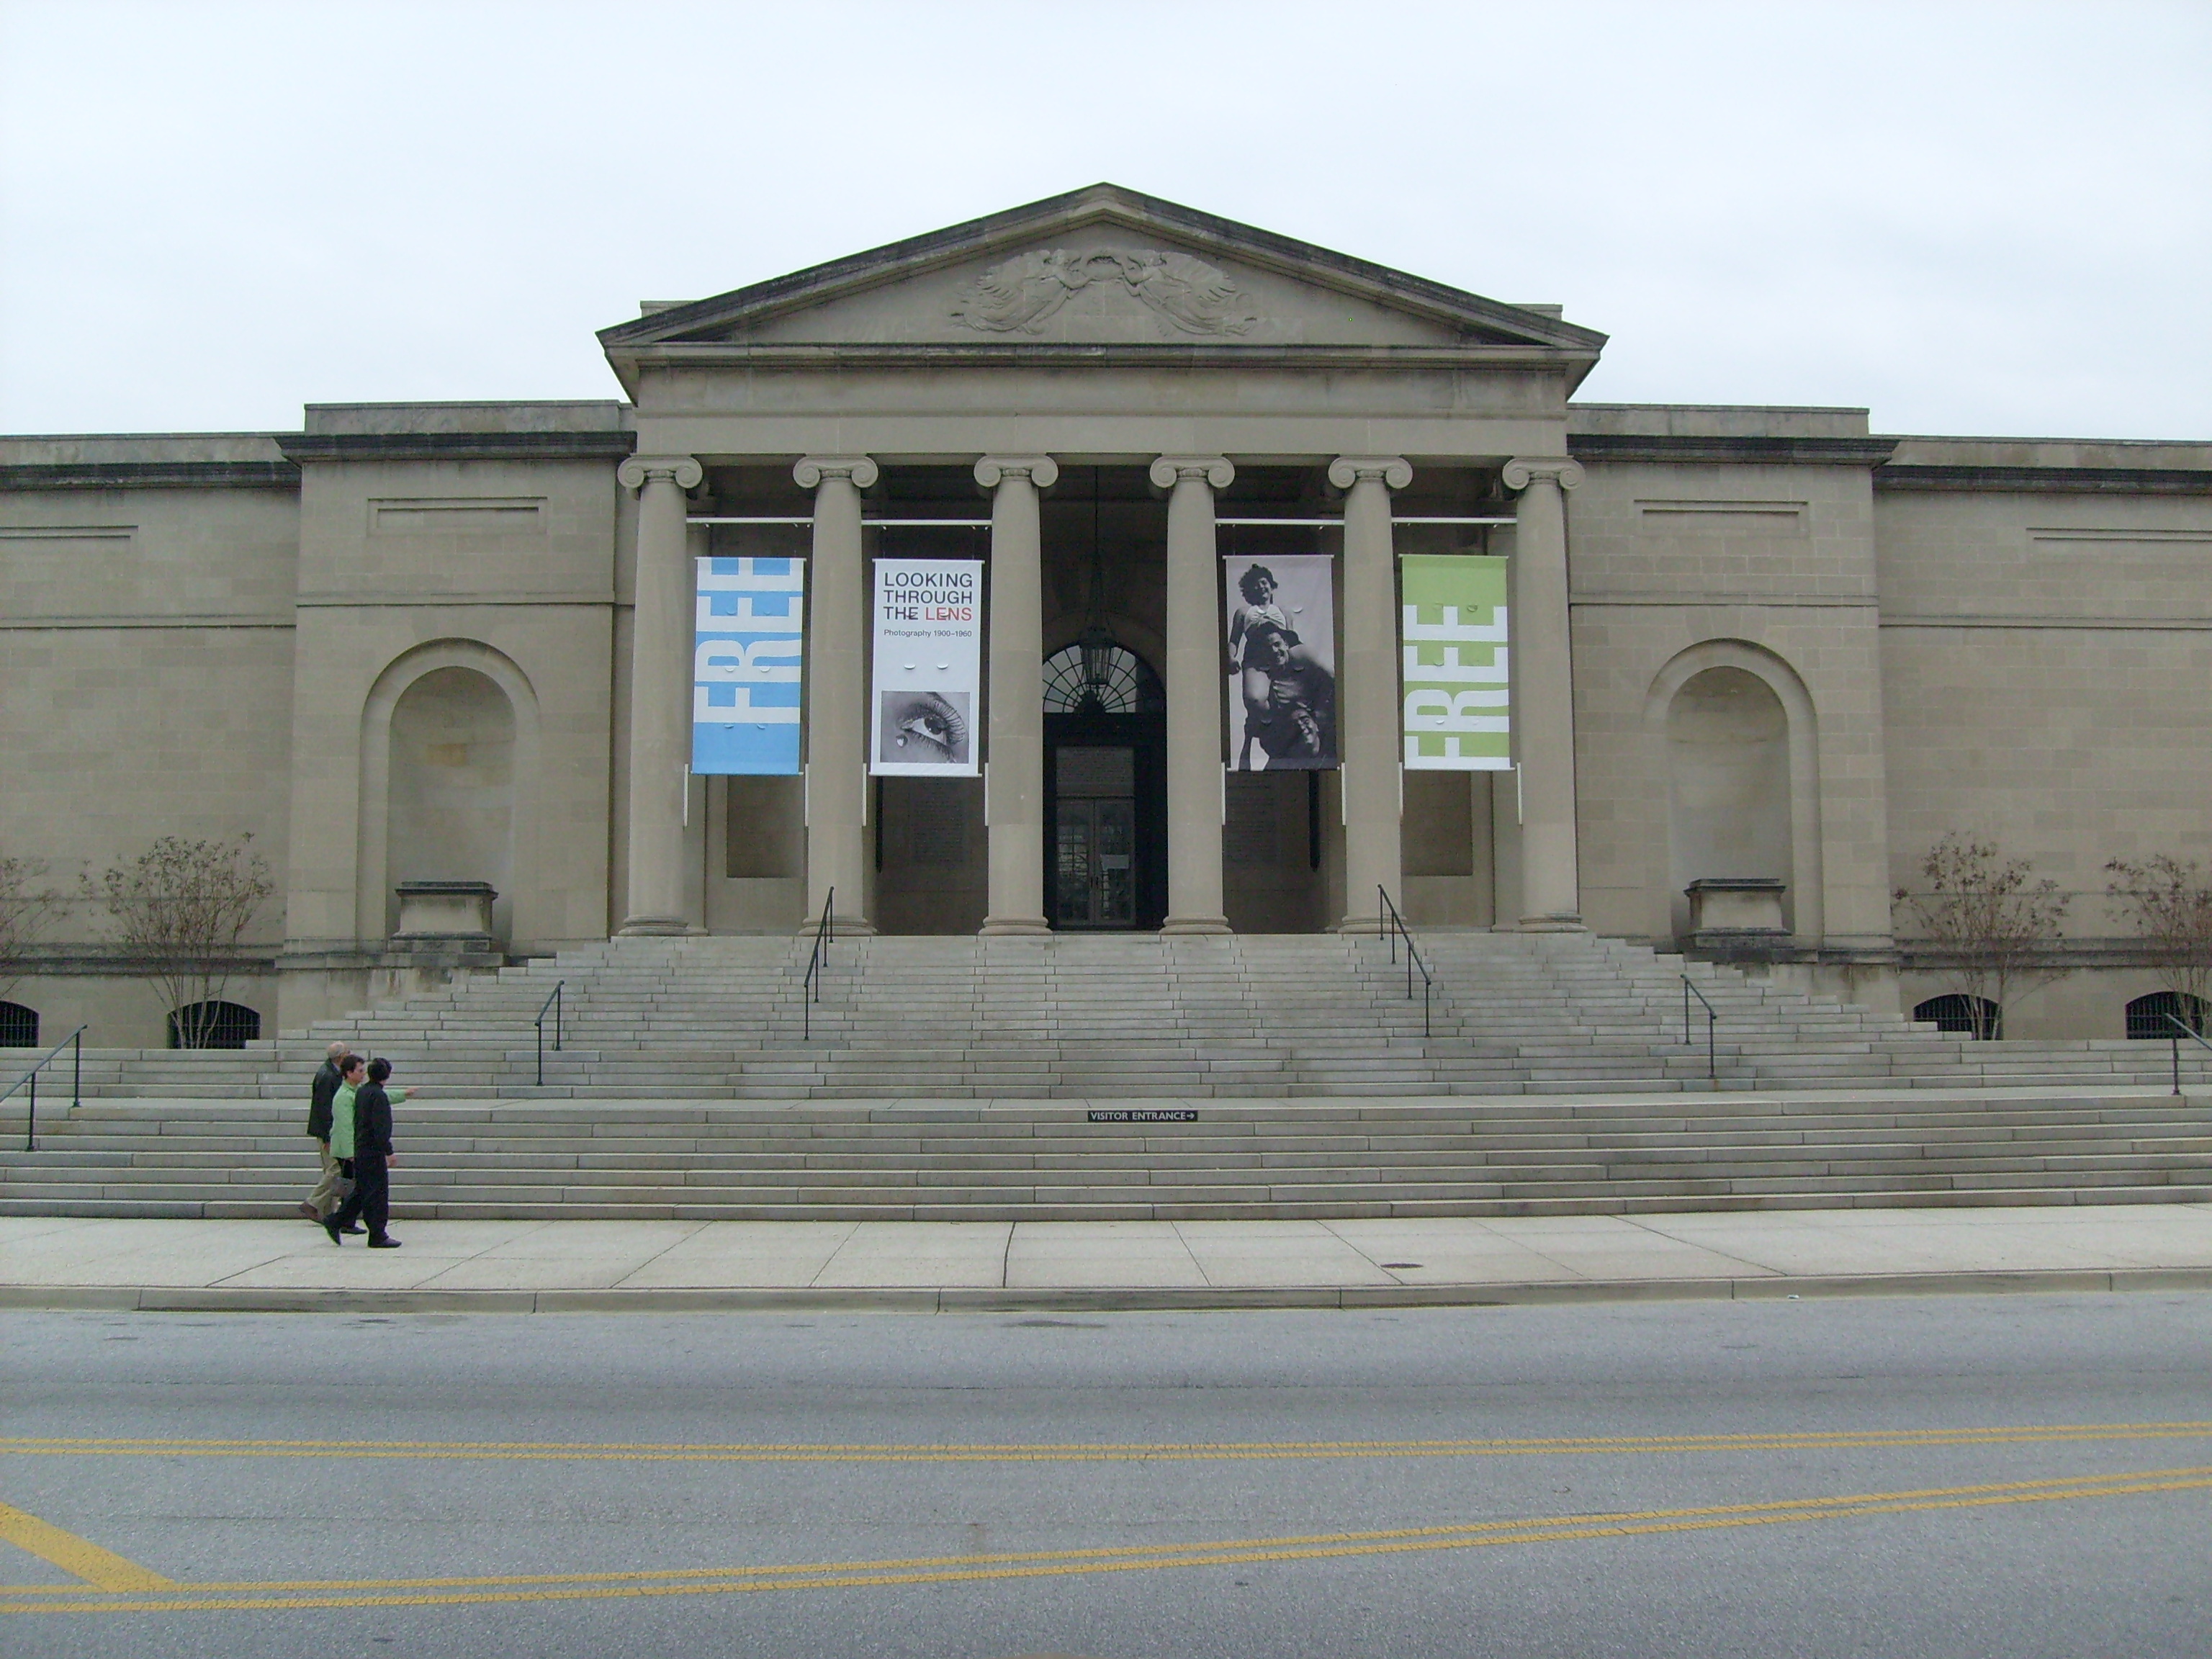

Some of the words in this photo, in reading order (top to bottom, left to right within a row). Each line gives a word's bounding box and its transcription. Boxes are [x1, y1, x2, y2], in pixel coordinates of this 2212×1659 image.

[884, 572, 973, 588] LOOKING
[884, 590, 972, 604] THROUGH
[883, 606, 919, 620] THE
[925, 607, 972, 621] LENS
[693, 558, 804, 724] FREE
[884, 629, 932, 638] Photography
[1403, 605, 1511, 768] FREE
[1090, 1111, 1129, 1120] VISITOR
[1132, 1111, 1186, 1120] ENTRANCE
